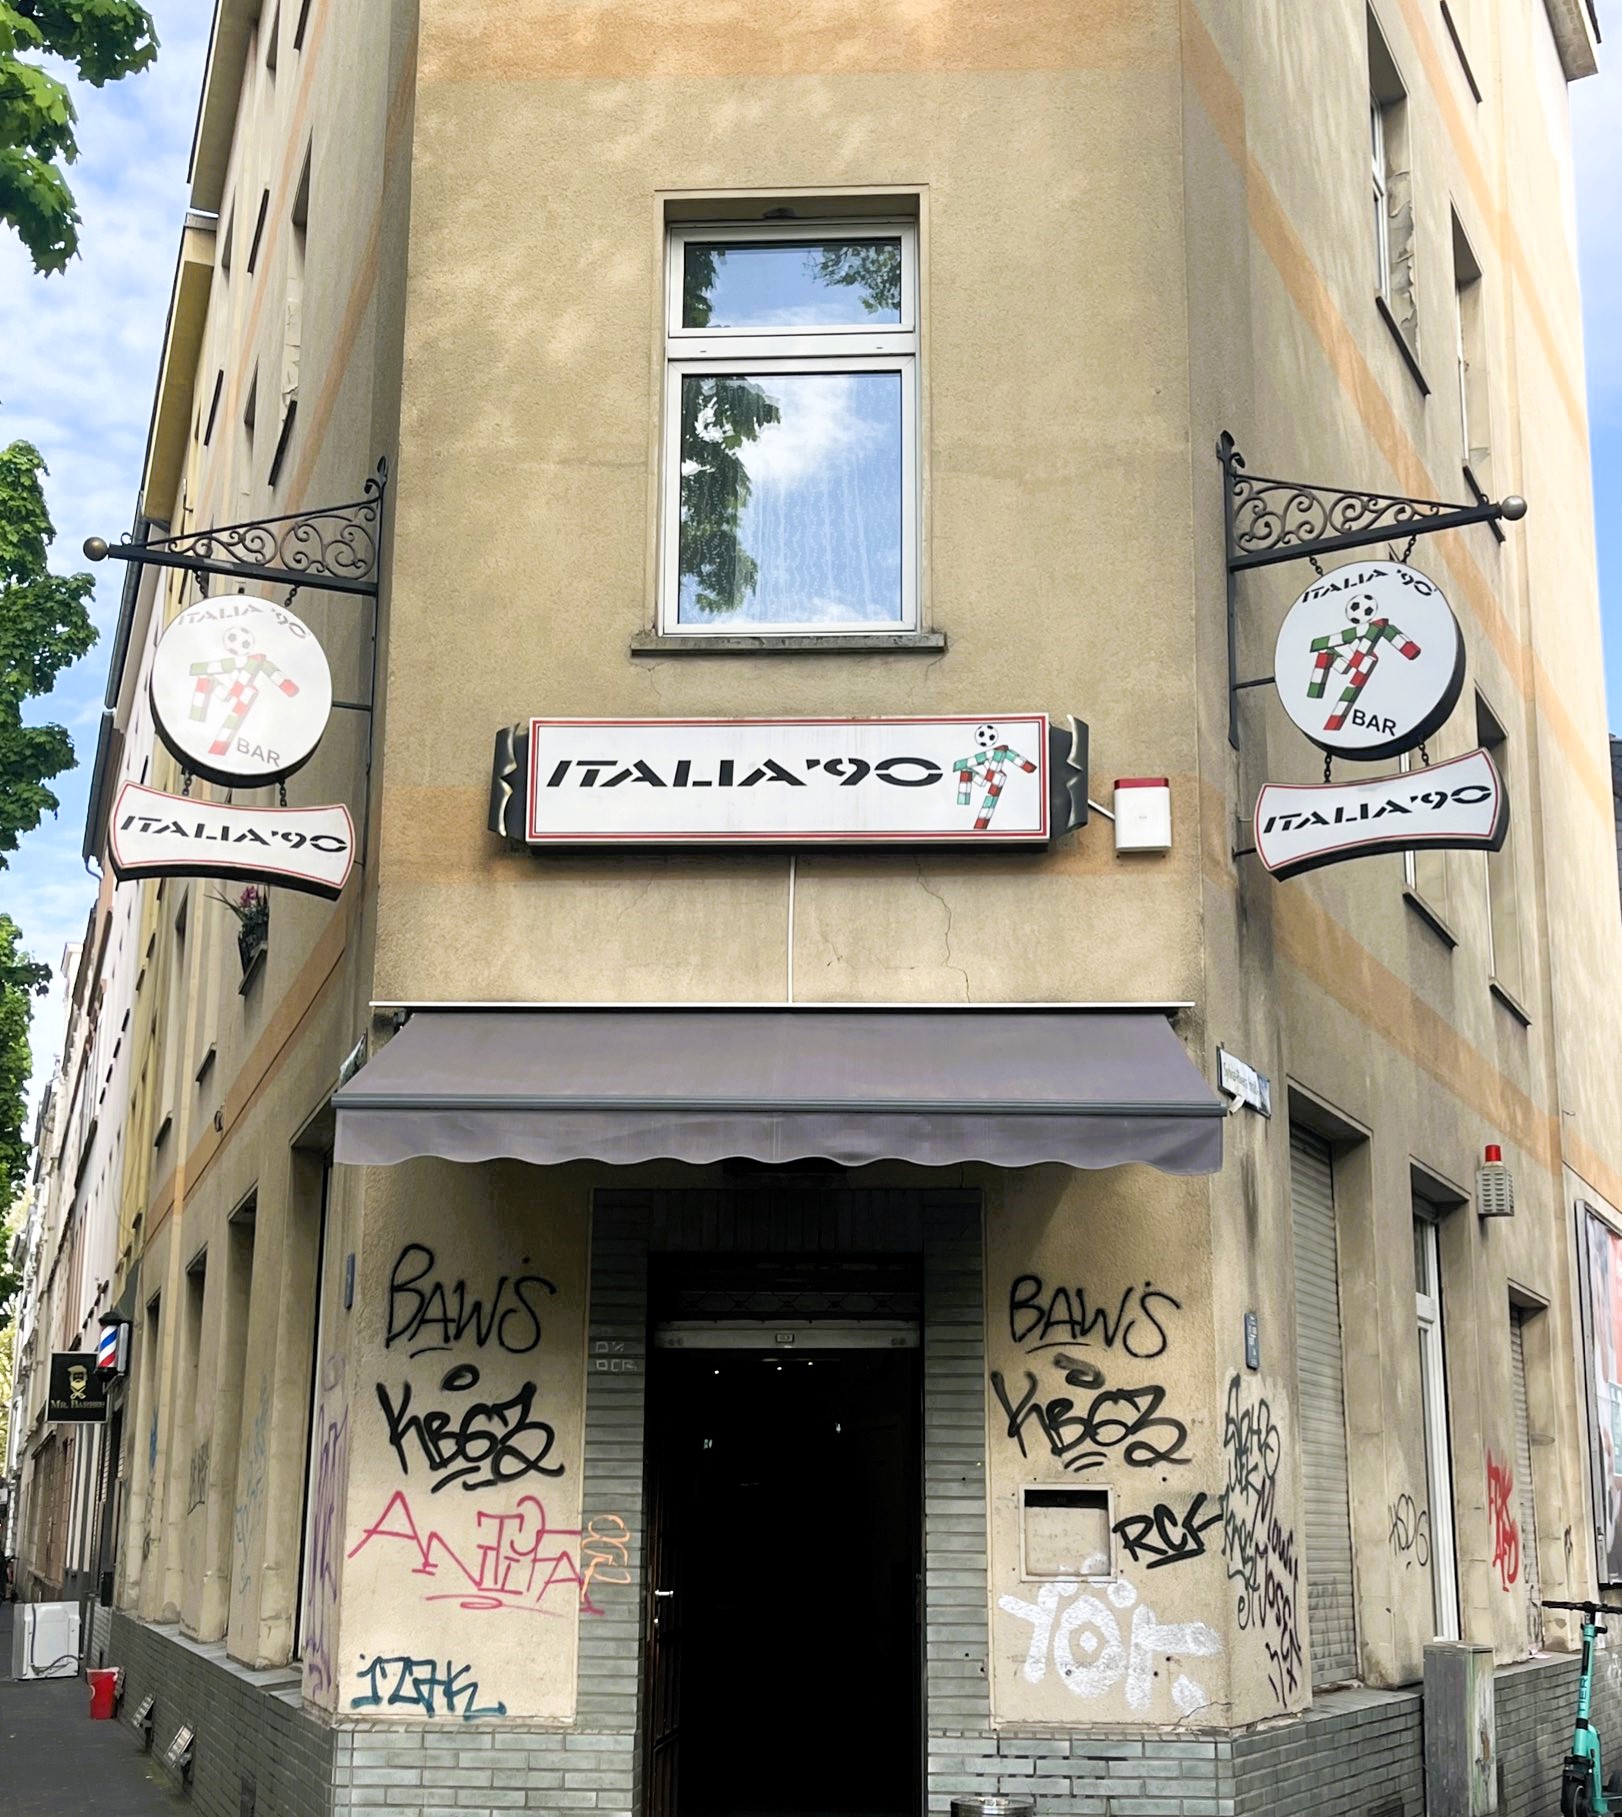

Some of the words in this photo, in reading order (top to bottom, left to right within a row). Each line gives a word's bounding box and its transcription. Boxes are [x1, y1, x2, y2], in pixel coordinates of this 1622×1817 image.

[1302, 568, 1389, 603] ITALIA
[178, 604, 264, 625] ITALIA
[1352, 708, 1396, 737] BAR
[236, 737, 281, 768] BAR
